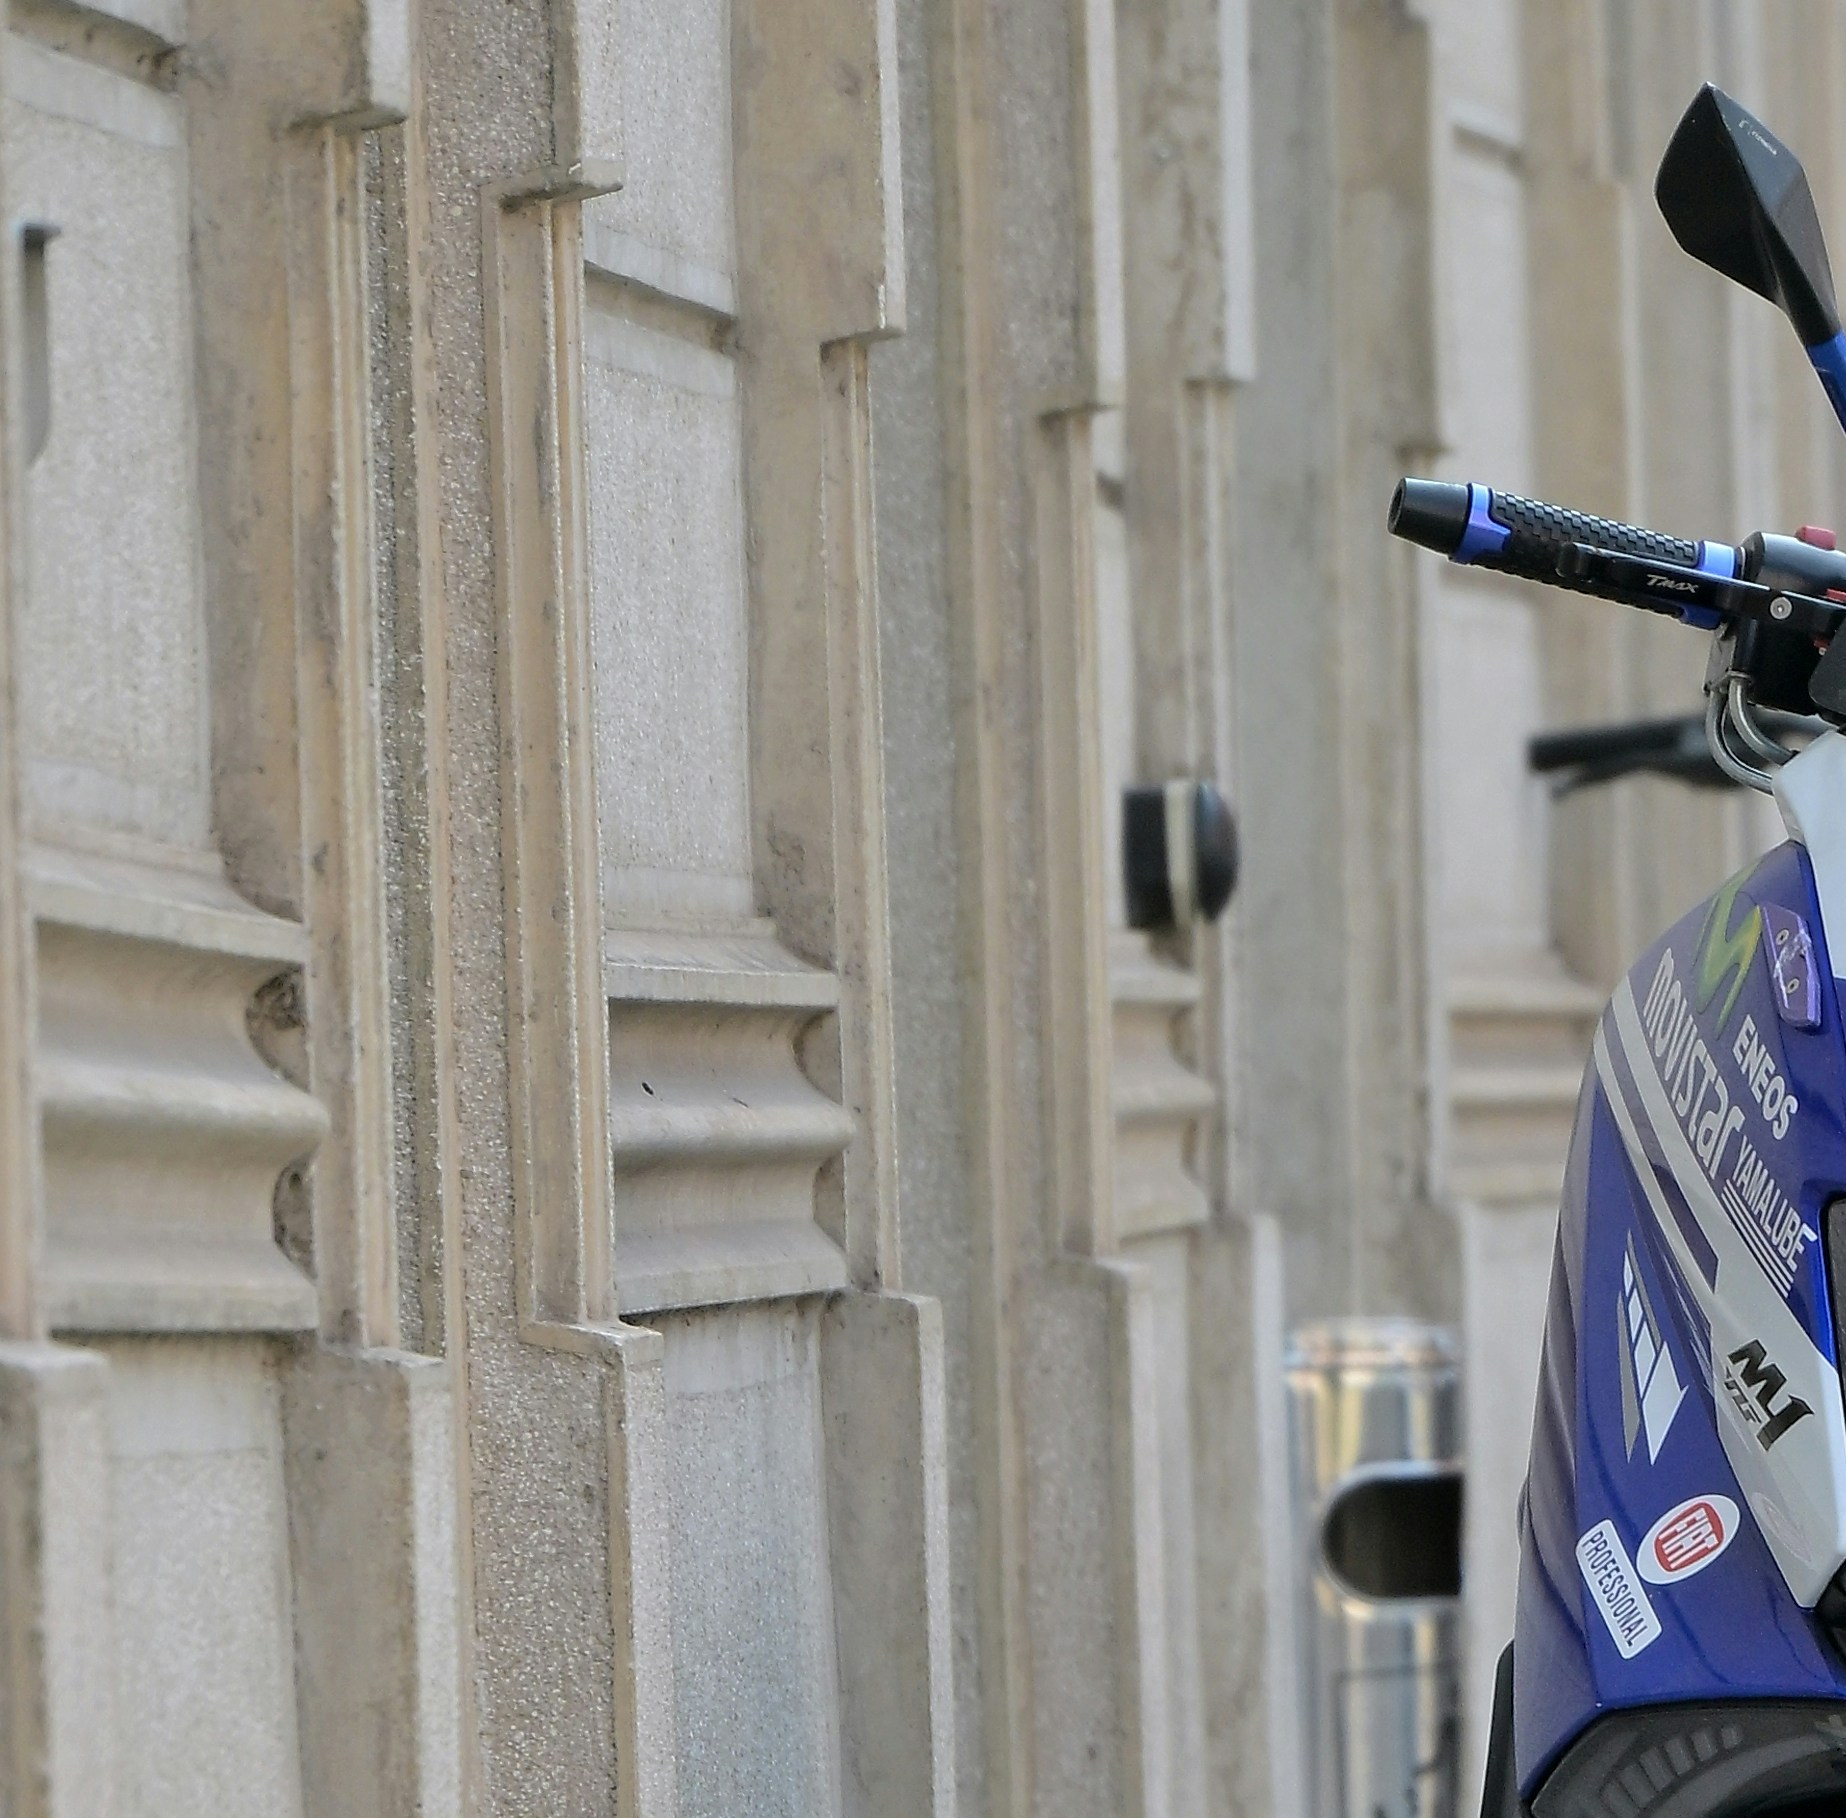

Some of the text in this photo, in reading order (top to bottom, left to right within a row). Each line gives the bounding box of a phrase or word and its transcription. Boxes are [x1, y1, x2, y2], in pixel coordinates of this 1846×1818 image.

[1643, 947, 1746, 1180] movistar
[1732, 1014, 1799, 1140] ENEOS
[1732, 1135, 1818, 1272] YAMALUBE
[1727, 1339, 1815, 1452] M1
[1581, 1529, 1649, 1648] PROFESSIONAL
[1657, 1506, 1720, 1570] FIAT
